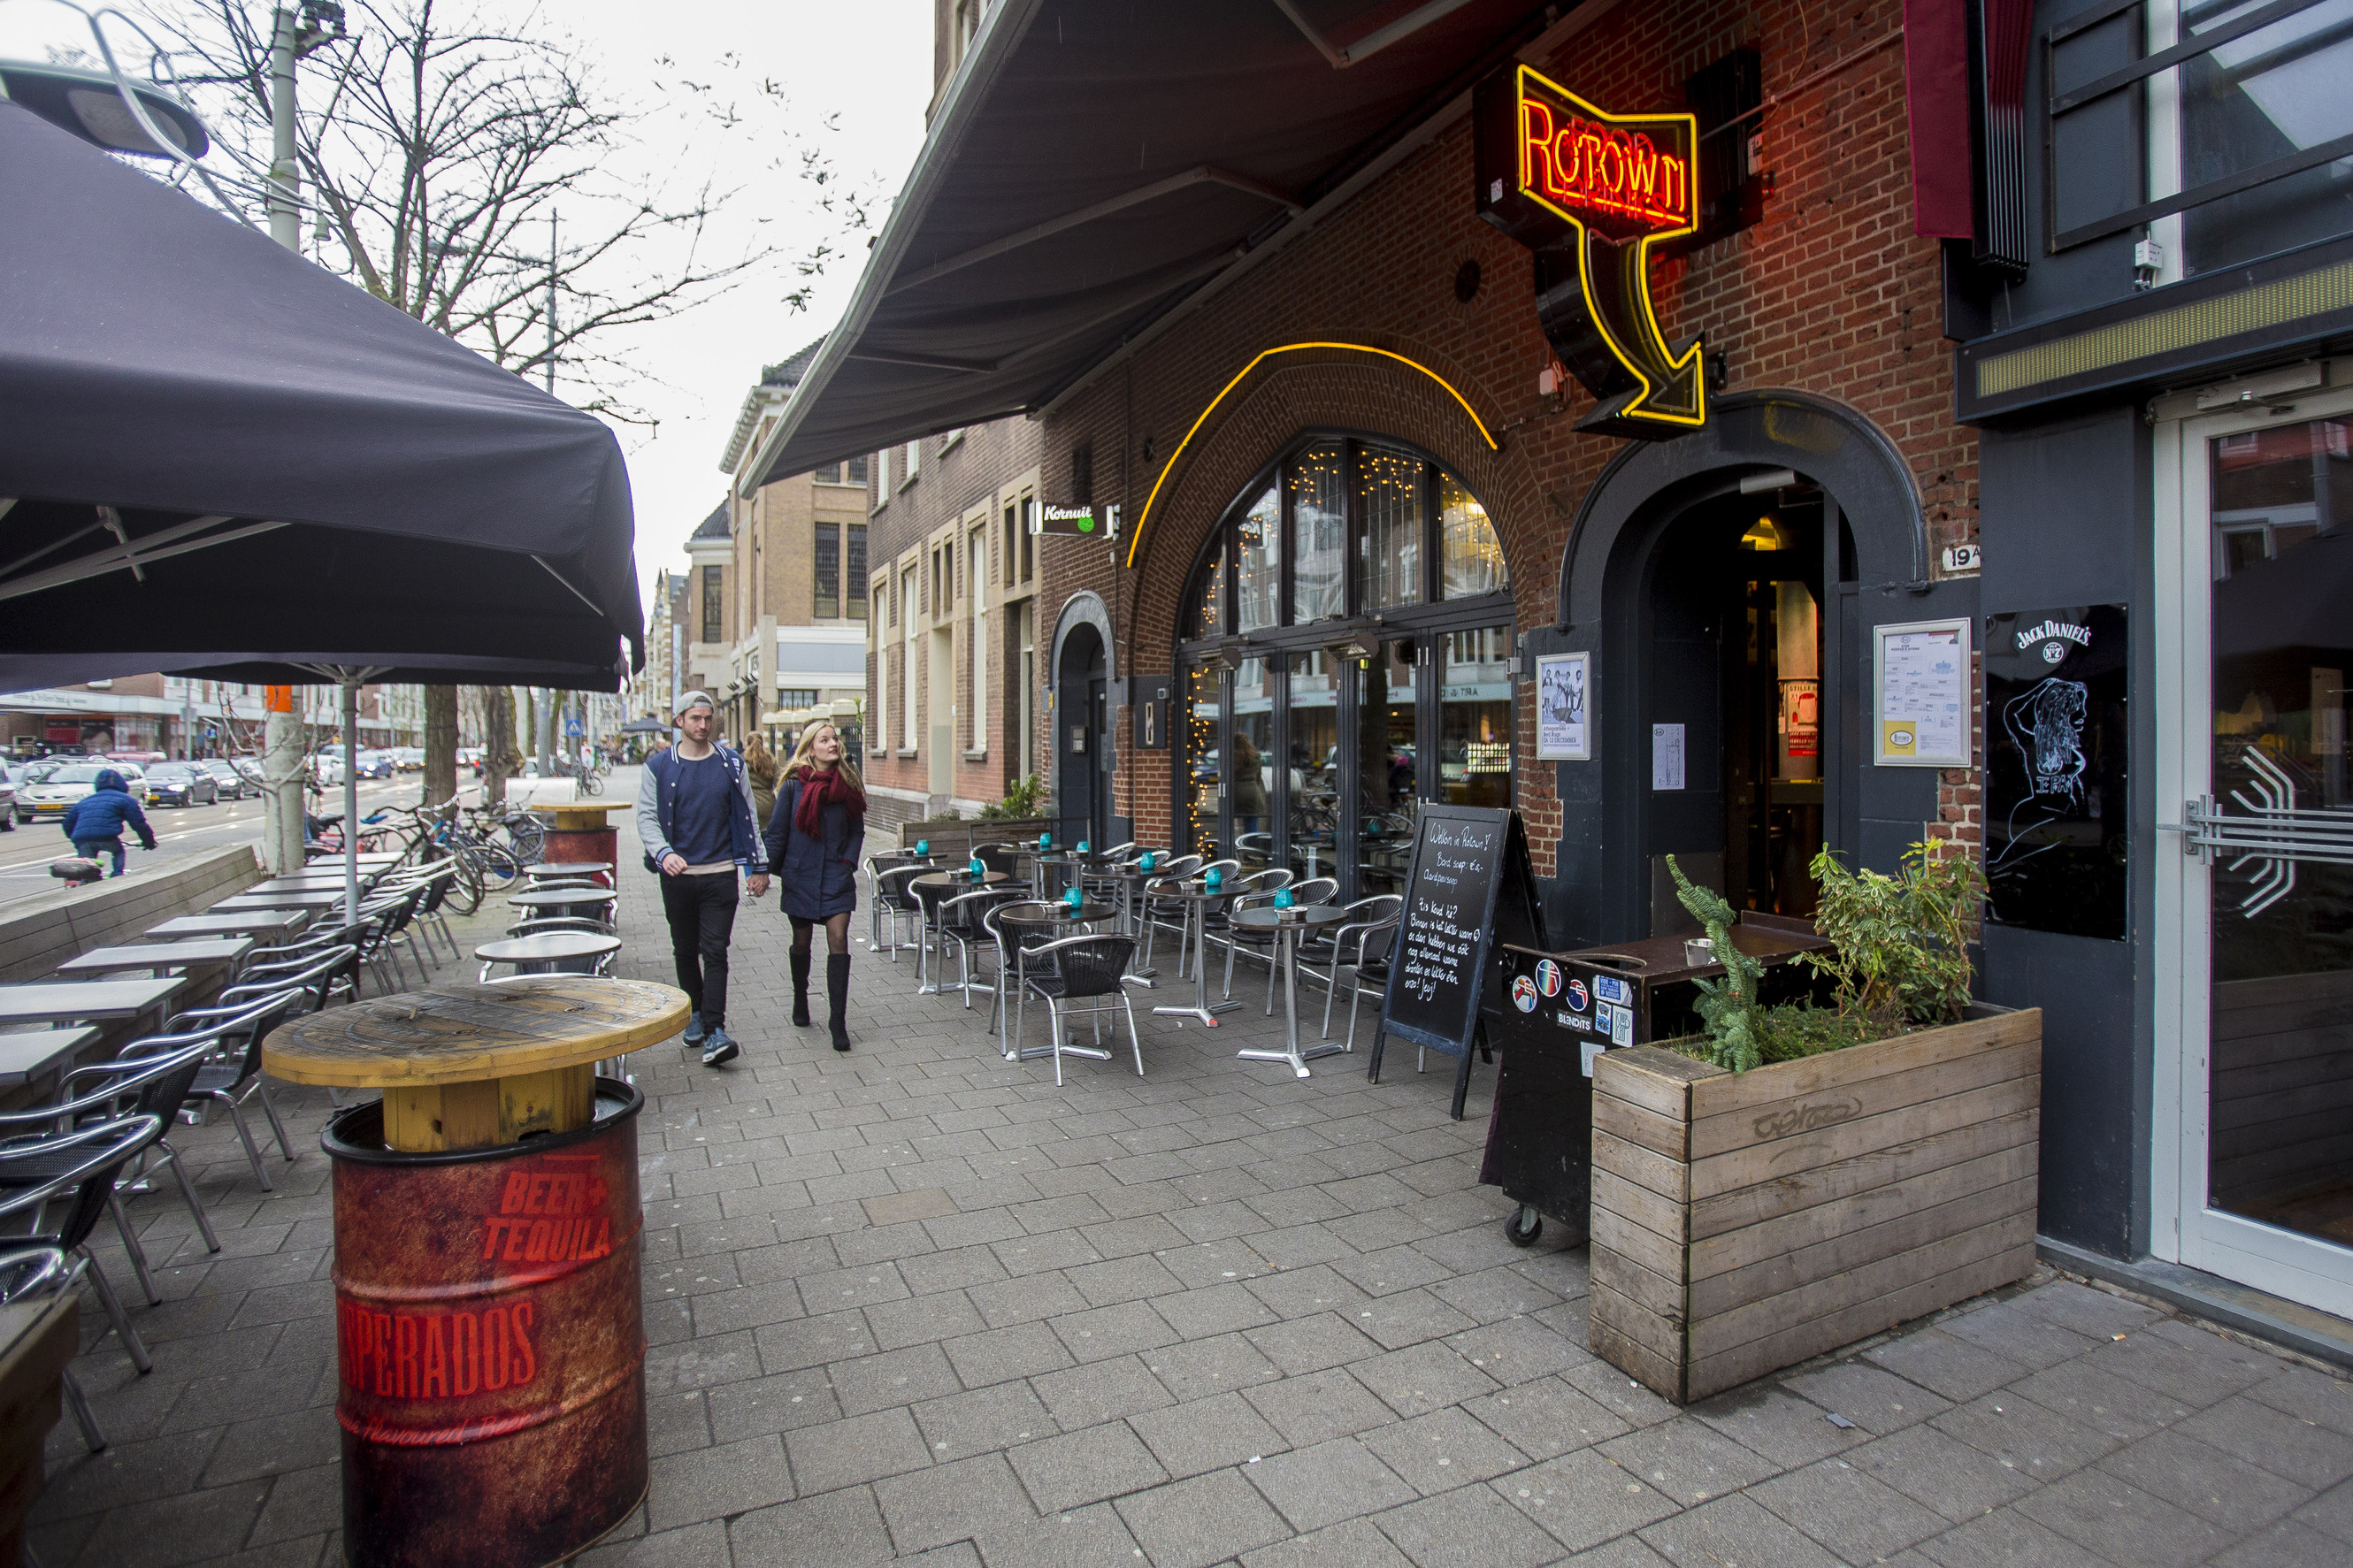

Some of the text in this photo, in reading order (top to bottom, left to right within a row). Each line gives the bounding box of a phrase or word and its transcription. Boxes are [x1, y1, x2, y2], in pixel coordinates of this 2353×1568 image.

[1044, 505, 1092, 521] Kornuit
[2017, 625, 2046, 649] JACK
[1454, 835, 1460, 846] in
[483, 1217, 610, 1262] TEQUILA
[478, 1414, 532, 1438] Beer
